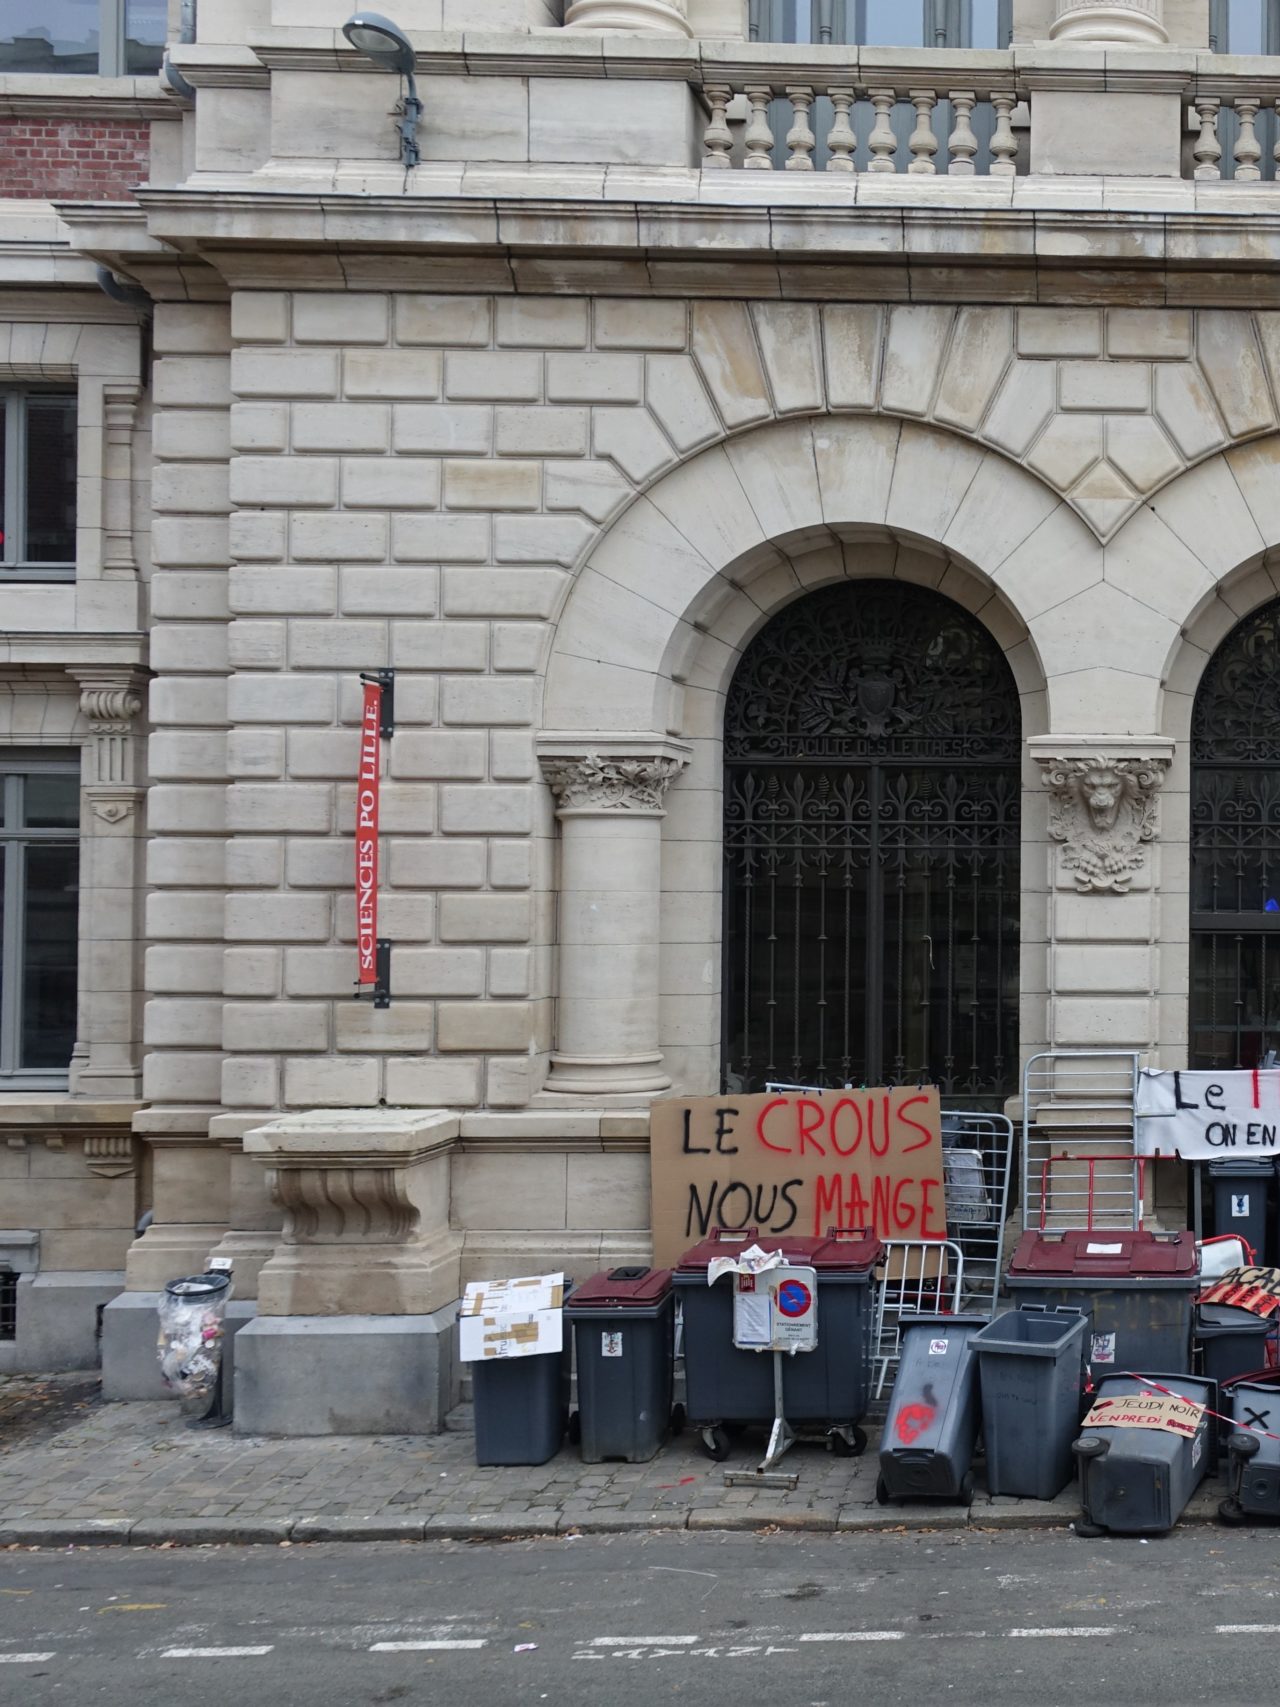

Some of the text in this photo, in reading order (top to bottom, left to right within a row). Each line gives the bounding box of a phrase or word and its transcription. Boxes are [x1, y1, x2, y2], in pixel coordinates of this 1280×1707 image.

[857, 739, 887, 757] DES
[892, 739, 963, 757] LETTRES
[360, 790, 374, 828] PO
[359, 839, 374, 969] SCIENCES
[682, 1095, 933, 1157] LE CROUS
[1205, 1121, 1236, 1147] ON
[1246, 1122, 1277, 1147] EN
[685, 1172, 947, 1239] NOUS MANGE
[1116, 1398, 1200, 1419] JEUDI NOIR
